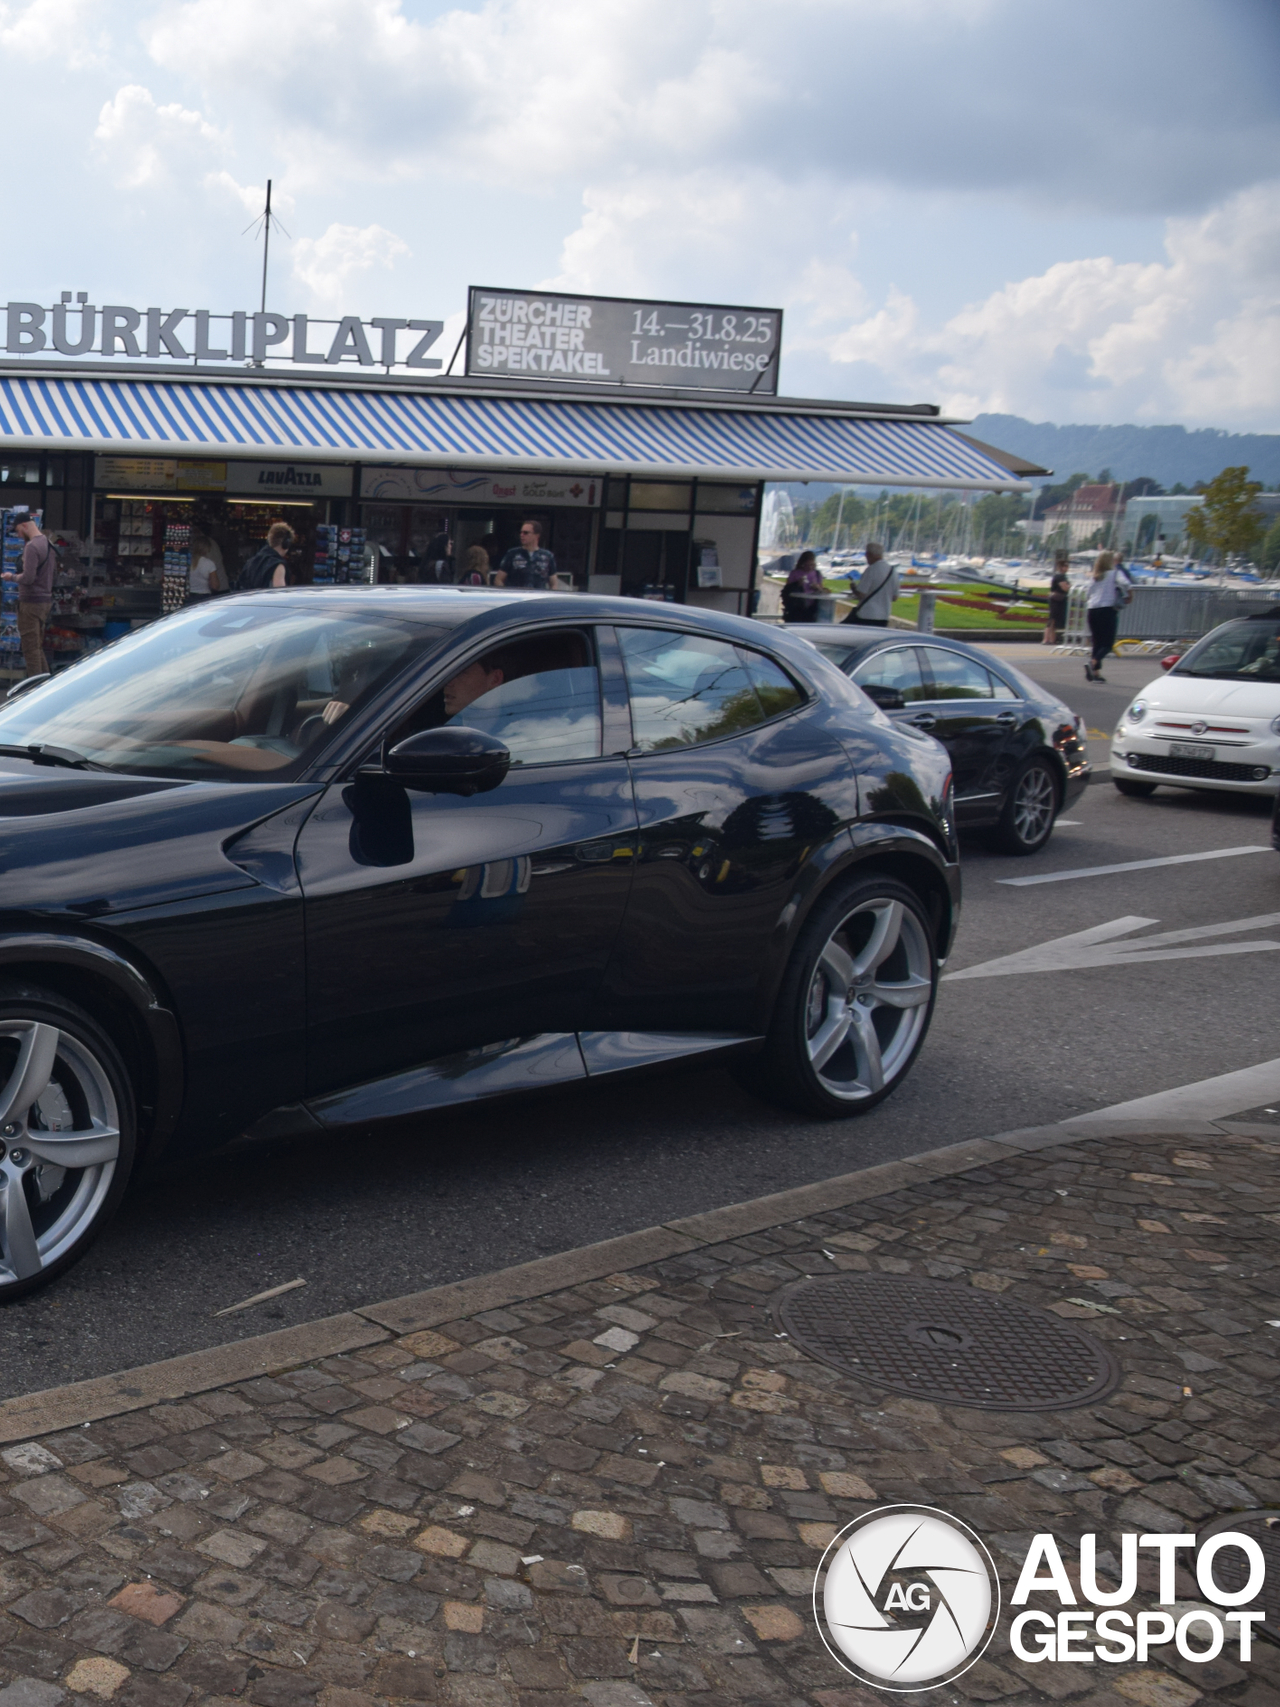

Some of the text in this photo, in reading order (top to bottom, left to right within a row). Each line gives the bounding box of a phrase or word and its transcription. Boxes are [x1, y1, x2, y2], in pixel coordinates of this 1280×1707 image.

[479, 297, 592, 329] ZÜRCHER
[7, 291, 444, 369] BÜRKLIPLATZ
[479, 321, 585, 351] THEATER
[477, 344, 610, 375] SPEKTAKEL
[629, 340, 770, 372] Landiwiese
[258, 466, 322, 486] LAVAZZA
